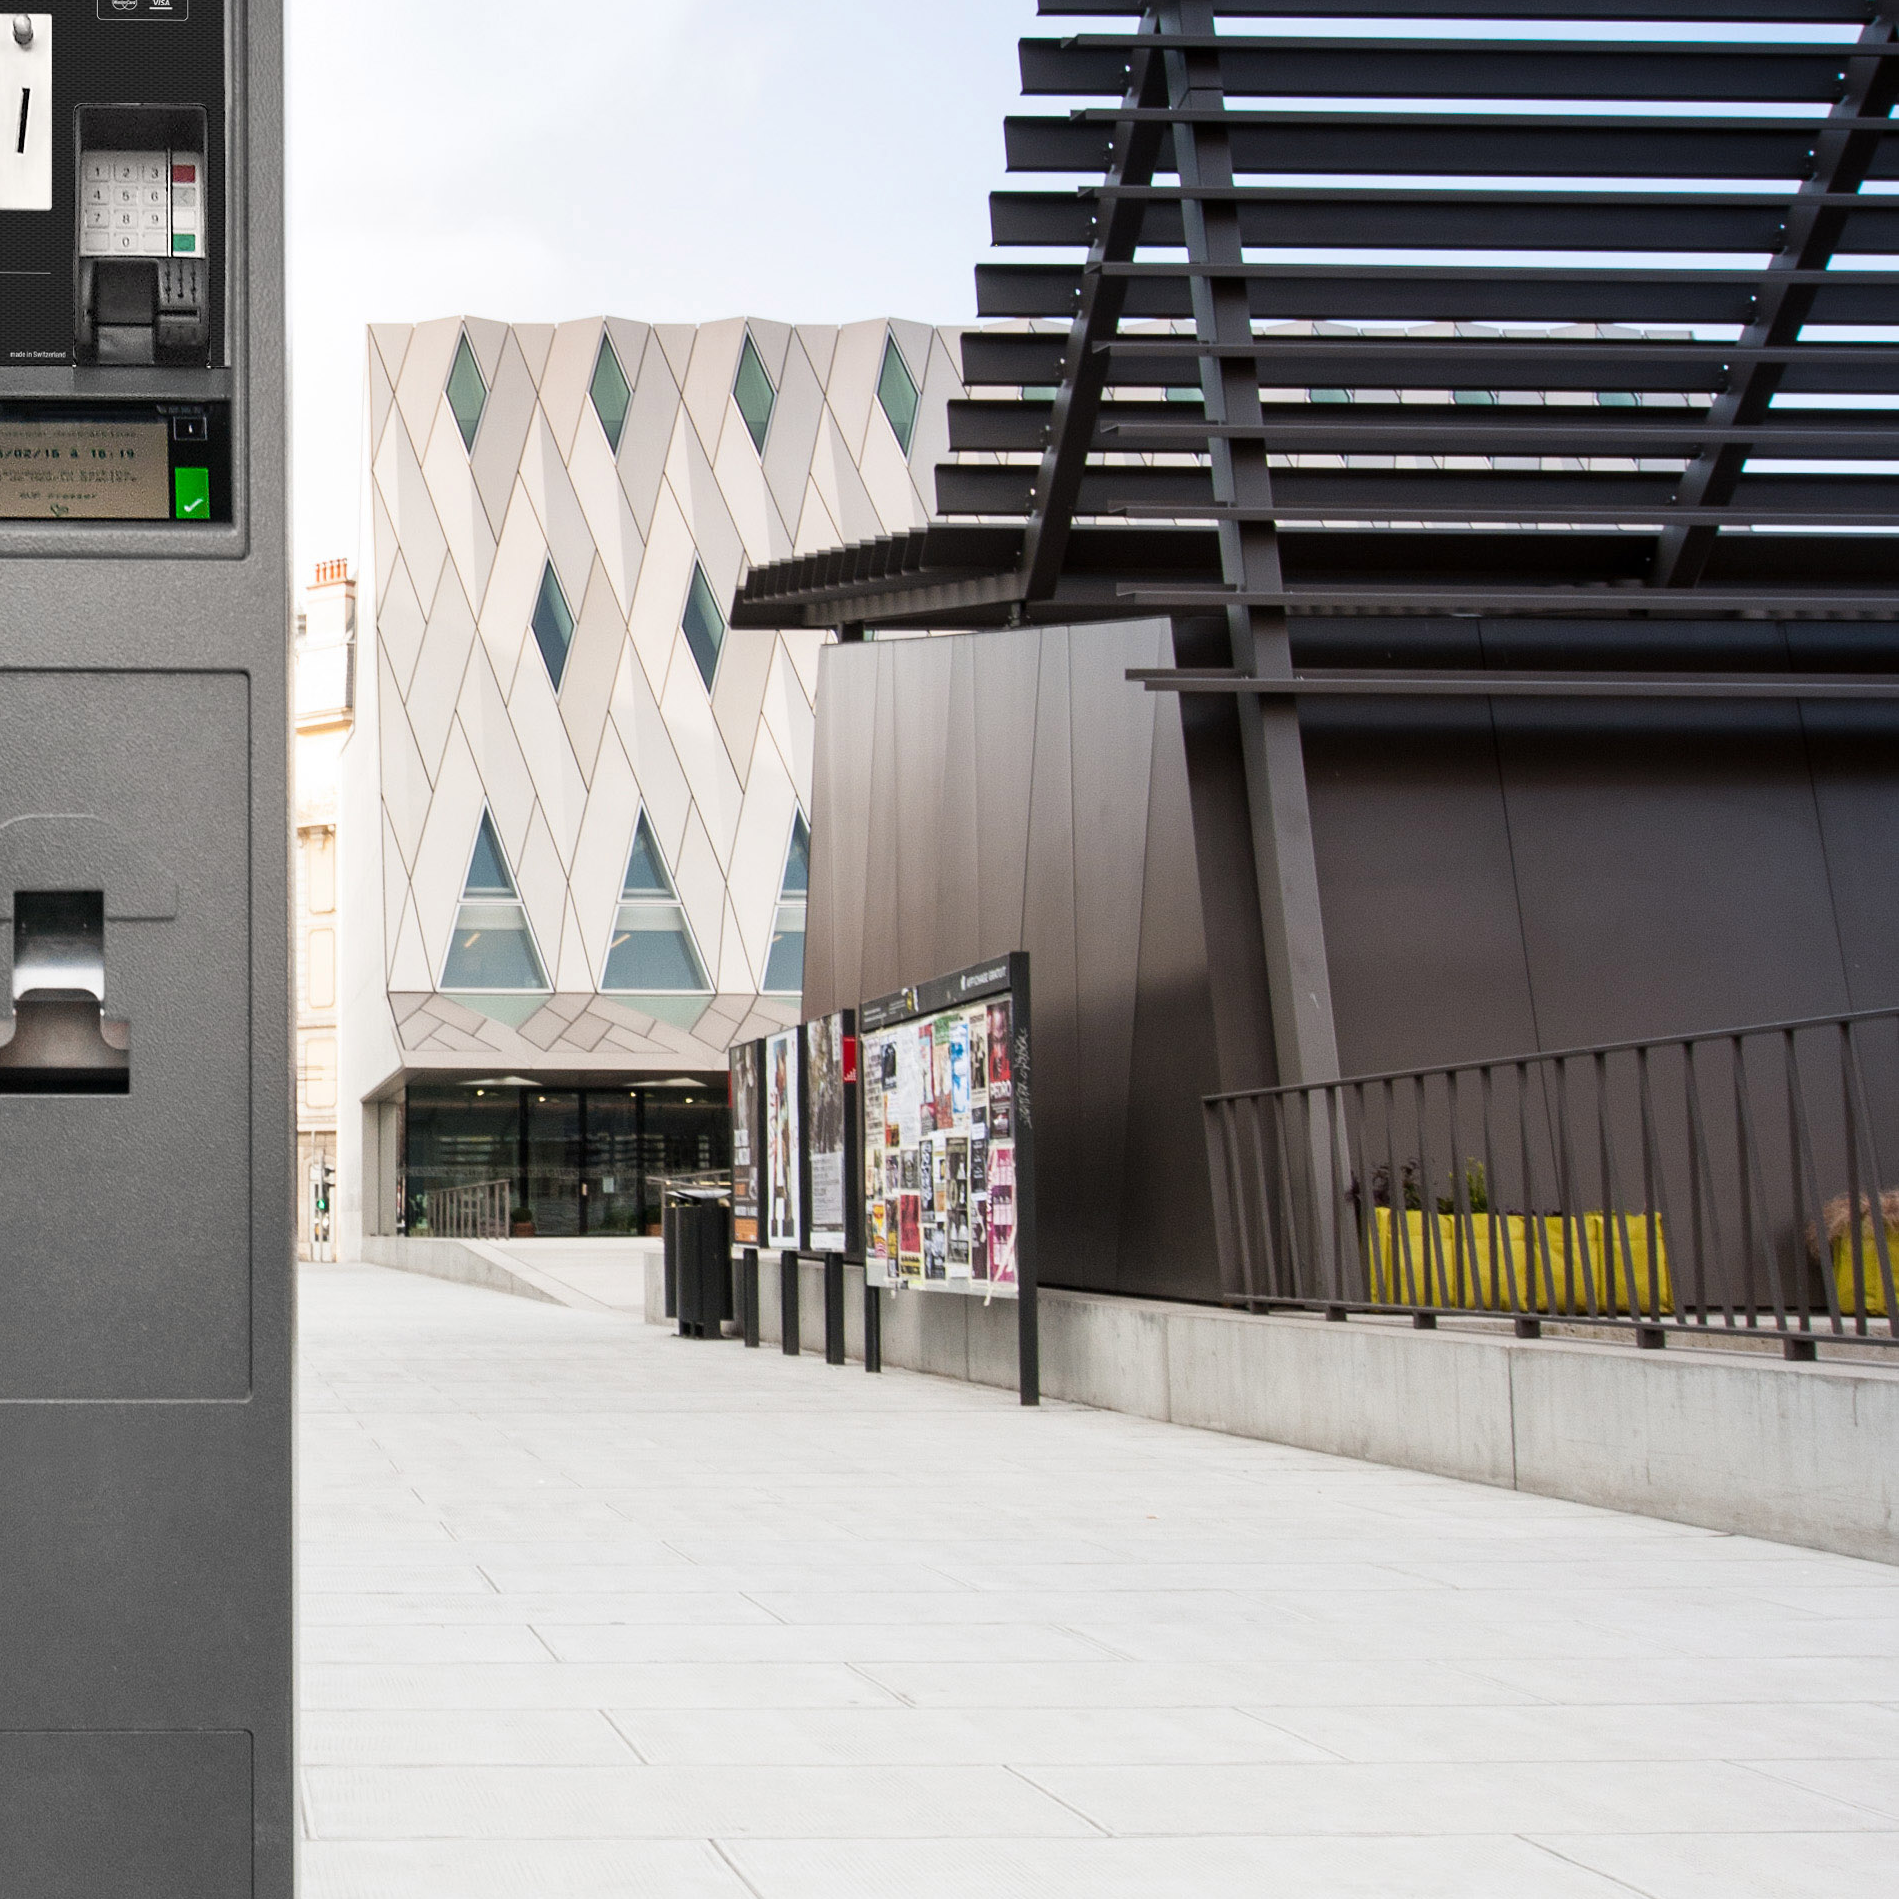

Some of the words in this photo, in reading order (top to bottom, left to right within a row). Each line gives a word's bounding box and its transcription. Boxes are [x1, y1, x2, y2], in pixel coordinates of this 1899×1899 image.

[152, 0, 171, 7] VISA
[123, 168, 130, 178] 2
[152, 167, 159, 179] 3
[93, 190, 101, 200] 4
[122, 191, 129, 201] 5
[151, 191, 158, 201] 6
[93, 213, 101, 222] 7
[122, 214, 130, 224] 8
[152, 214, 159, 224] 9
[122, 237, 130, 247] 0
[33, 351, 67, 359] Switzerland
